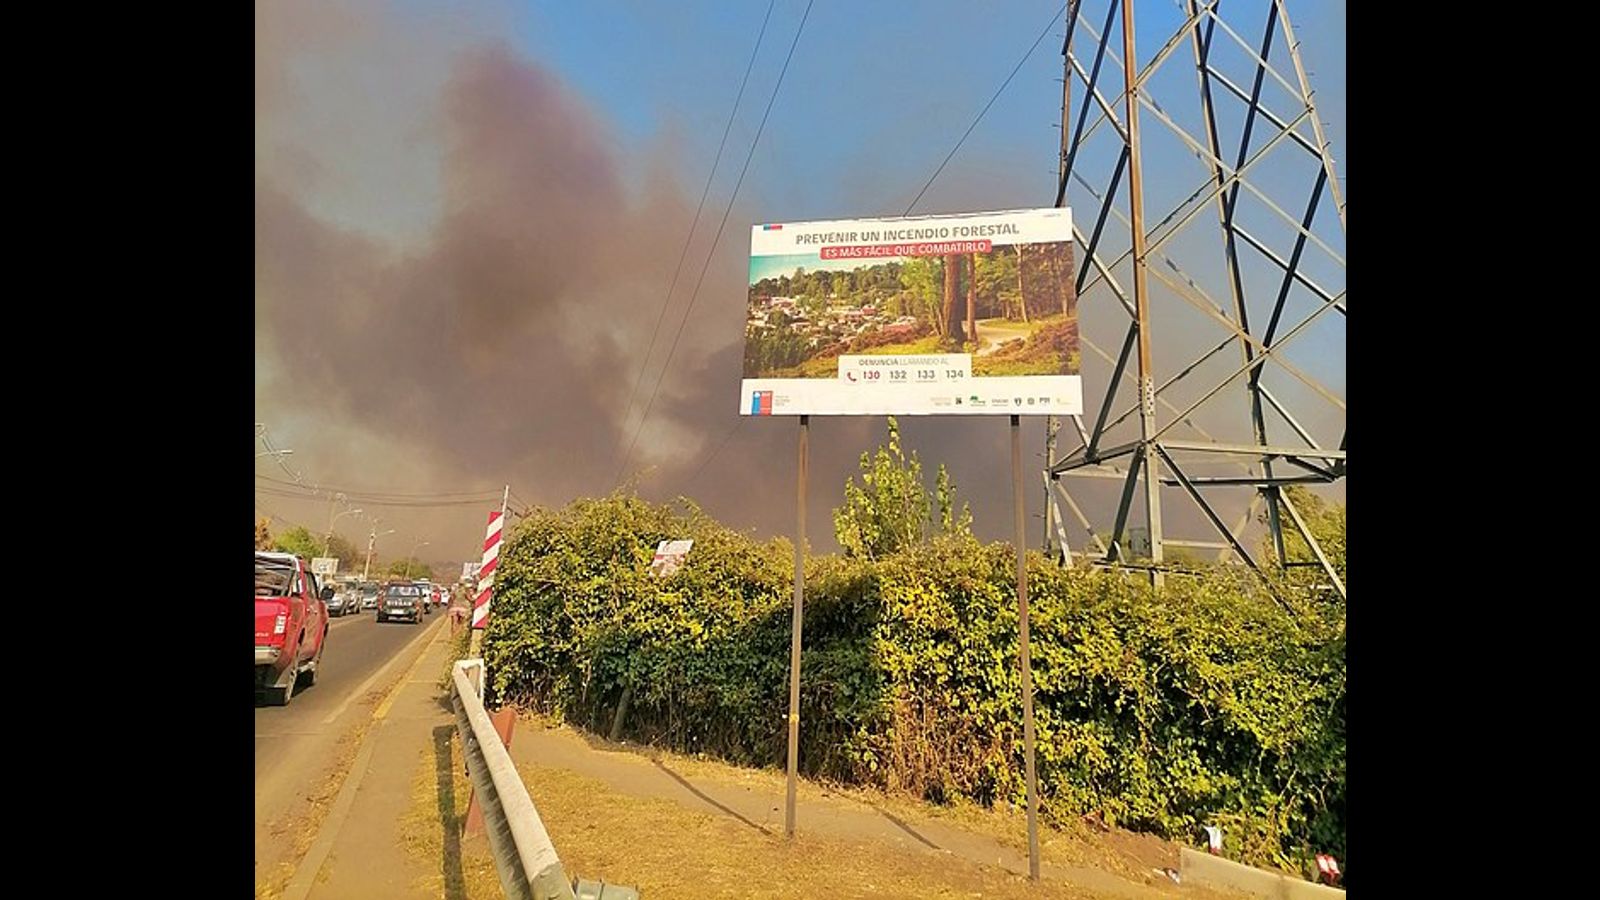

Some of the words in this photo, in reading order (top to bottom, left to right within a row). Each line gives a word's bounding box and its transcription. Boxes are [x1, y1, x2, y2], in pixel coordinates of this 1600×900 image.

[796, 231, 858, 245] PREVENIR
[860, 231, 880, 242] UN
[883, 226, 949, 241] INCENDIO
[952, 223, 1020, 238] FORESTAL
[825, 248, 837, 257] ES
[839, 246, 862, 257] MÁS
[863, 245, 893, 257] FÁCIL
[894, 245, 917, 256] QUE
[918, 241, 986, 255] COMBATIRLO
[858, 358, 899, 366] DENUNCIA
[863, 370, 880, 380] 130
[890, 370, 907, 379] 132
[917, 370, 935, 379] 133
[945, 369, 964, 378] 134
